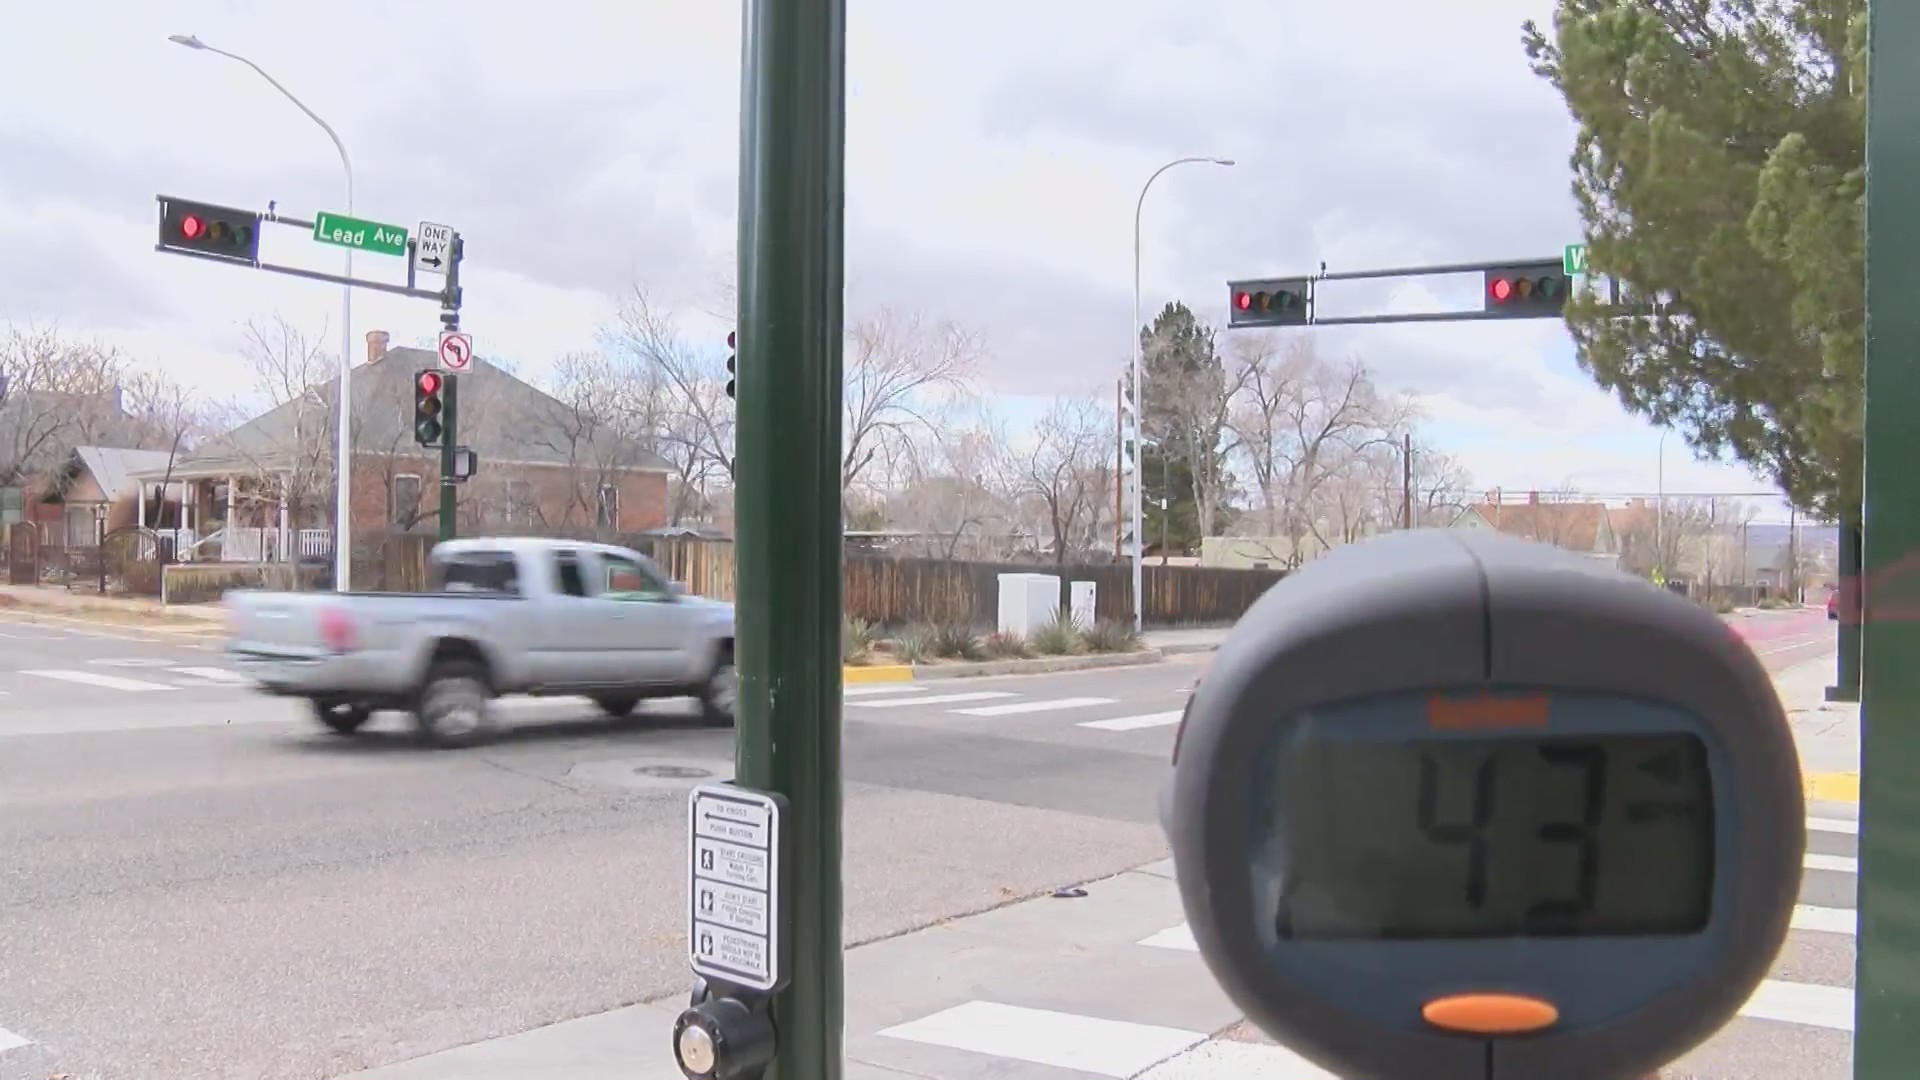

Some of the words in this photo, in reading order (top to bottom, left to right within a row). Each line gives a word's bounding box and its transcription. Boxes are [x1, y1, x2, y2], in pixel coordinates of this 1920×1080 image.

[319, 216, 365, 246] Lead
[373, 228, 403, 246] Ave
[424, 227, 448, 240] ONE
[422, 241, 447, 254] WAY
[1417, 744, 1609, 929] 43
